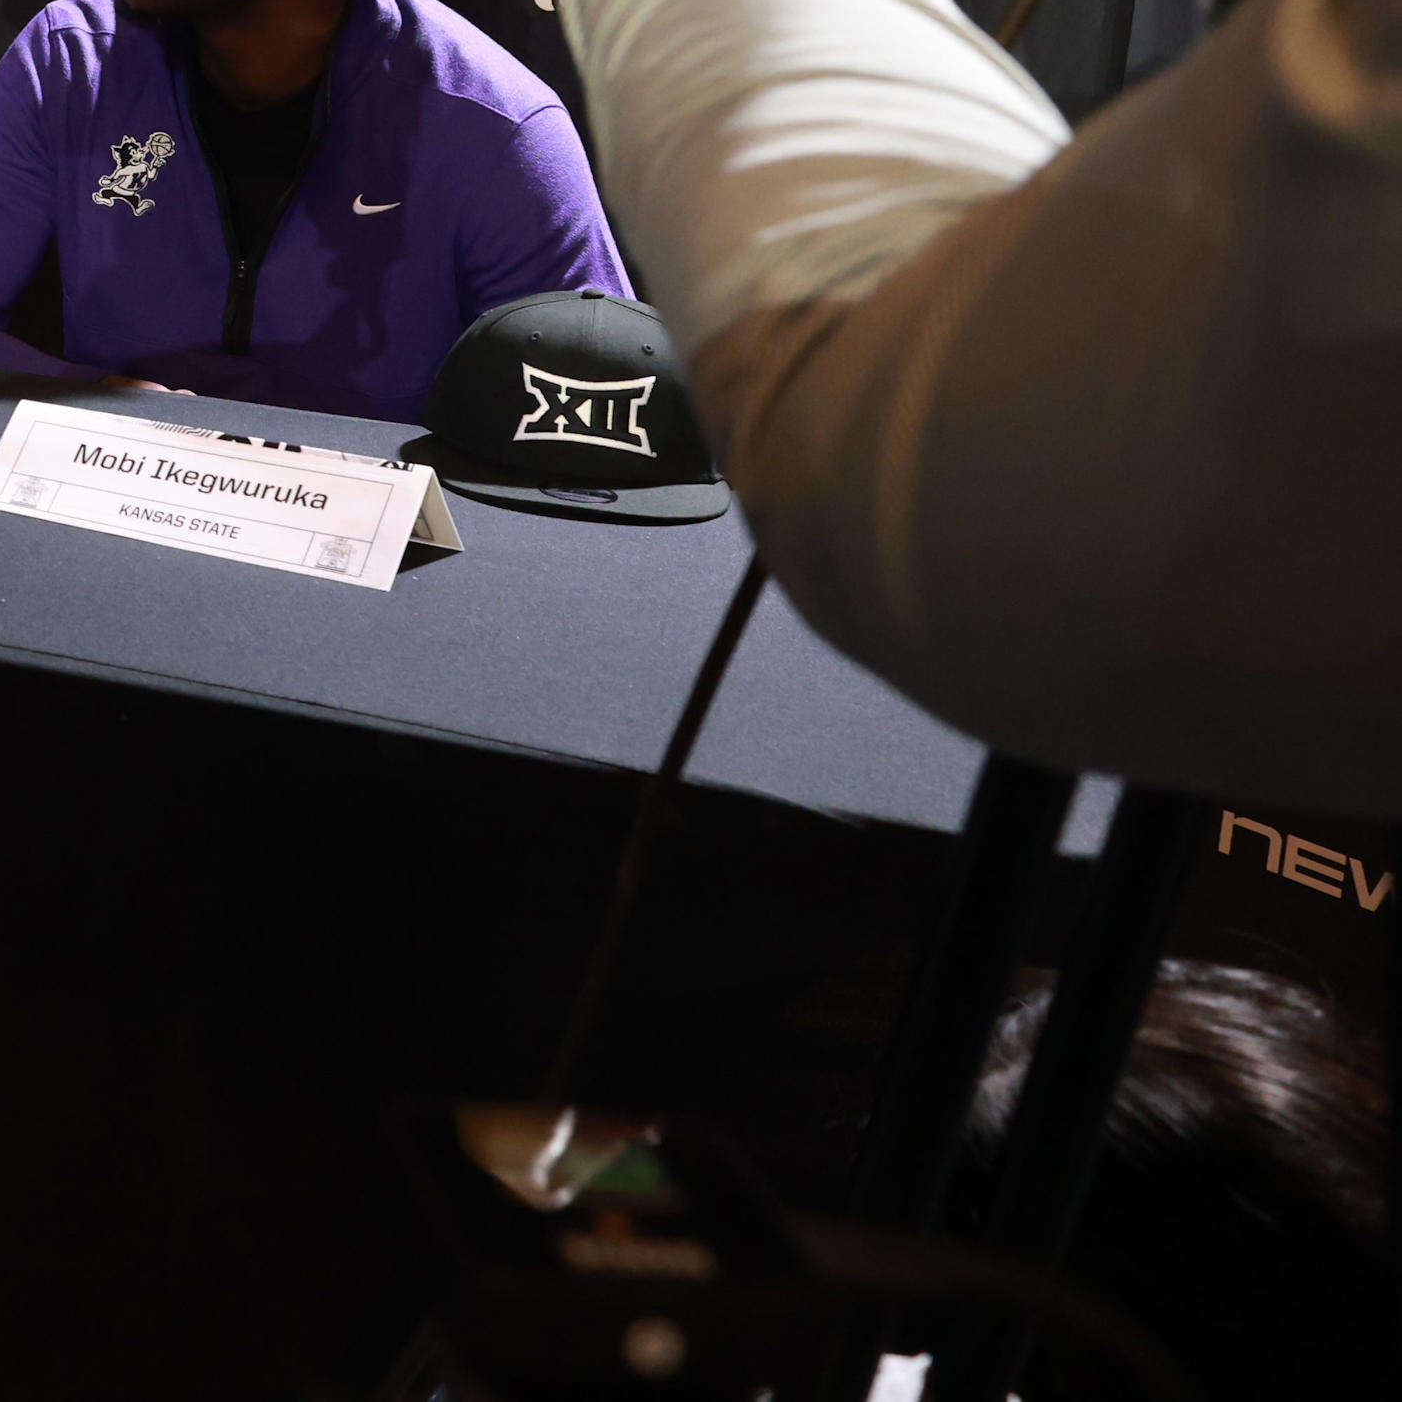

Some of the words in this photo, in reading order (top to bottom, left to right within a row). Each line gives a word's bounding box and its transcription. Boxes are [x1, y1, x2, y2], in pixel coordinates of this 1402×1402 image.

[519, 369, 650, 452] XII
[73, 443, 147, 475] Mobi
[150, 458, 329, 510] Ikegwuruka
[118, 503, 186, 528] KANSAS
[188, 518, 242, 540] STATE
